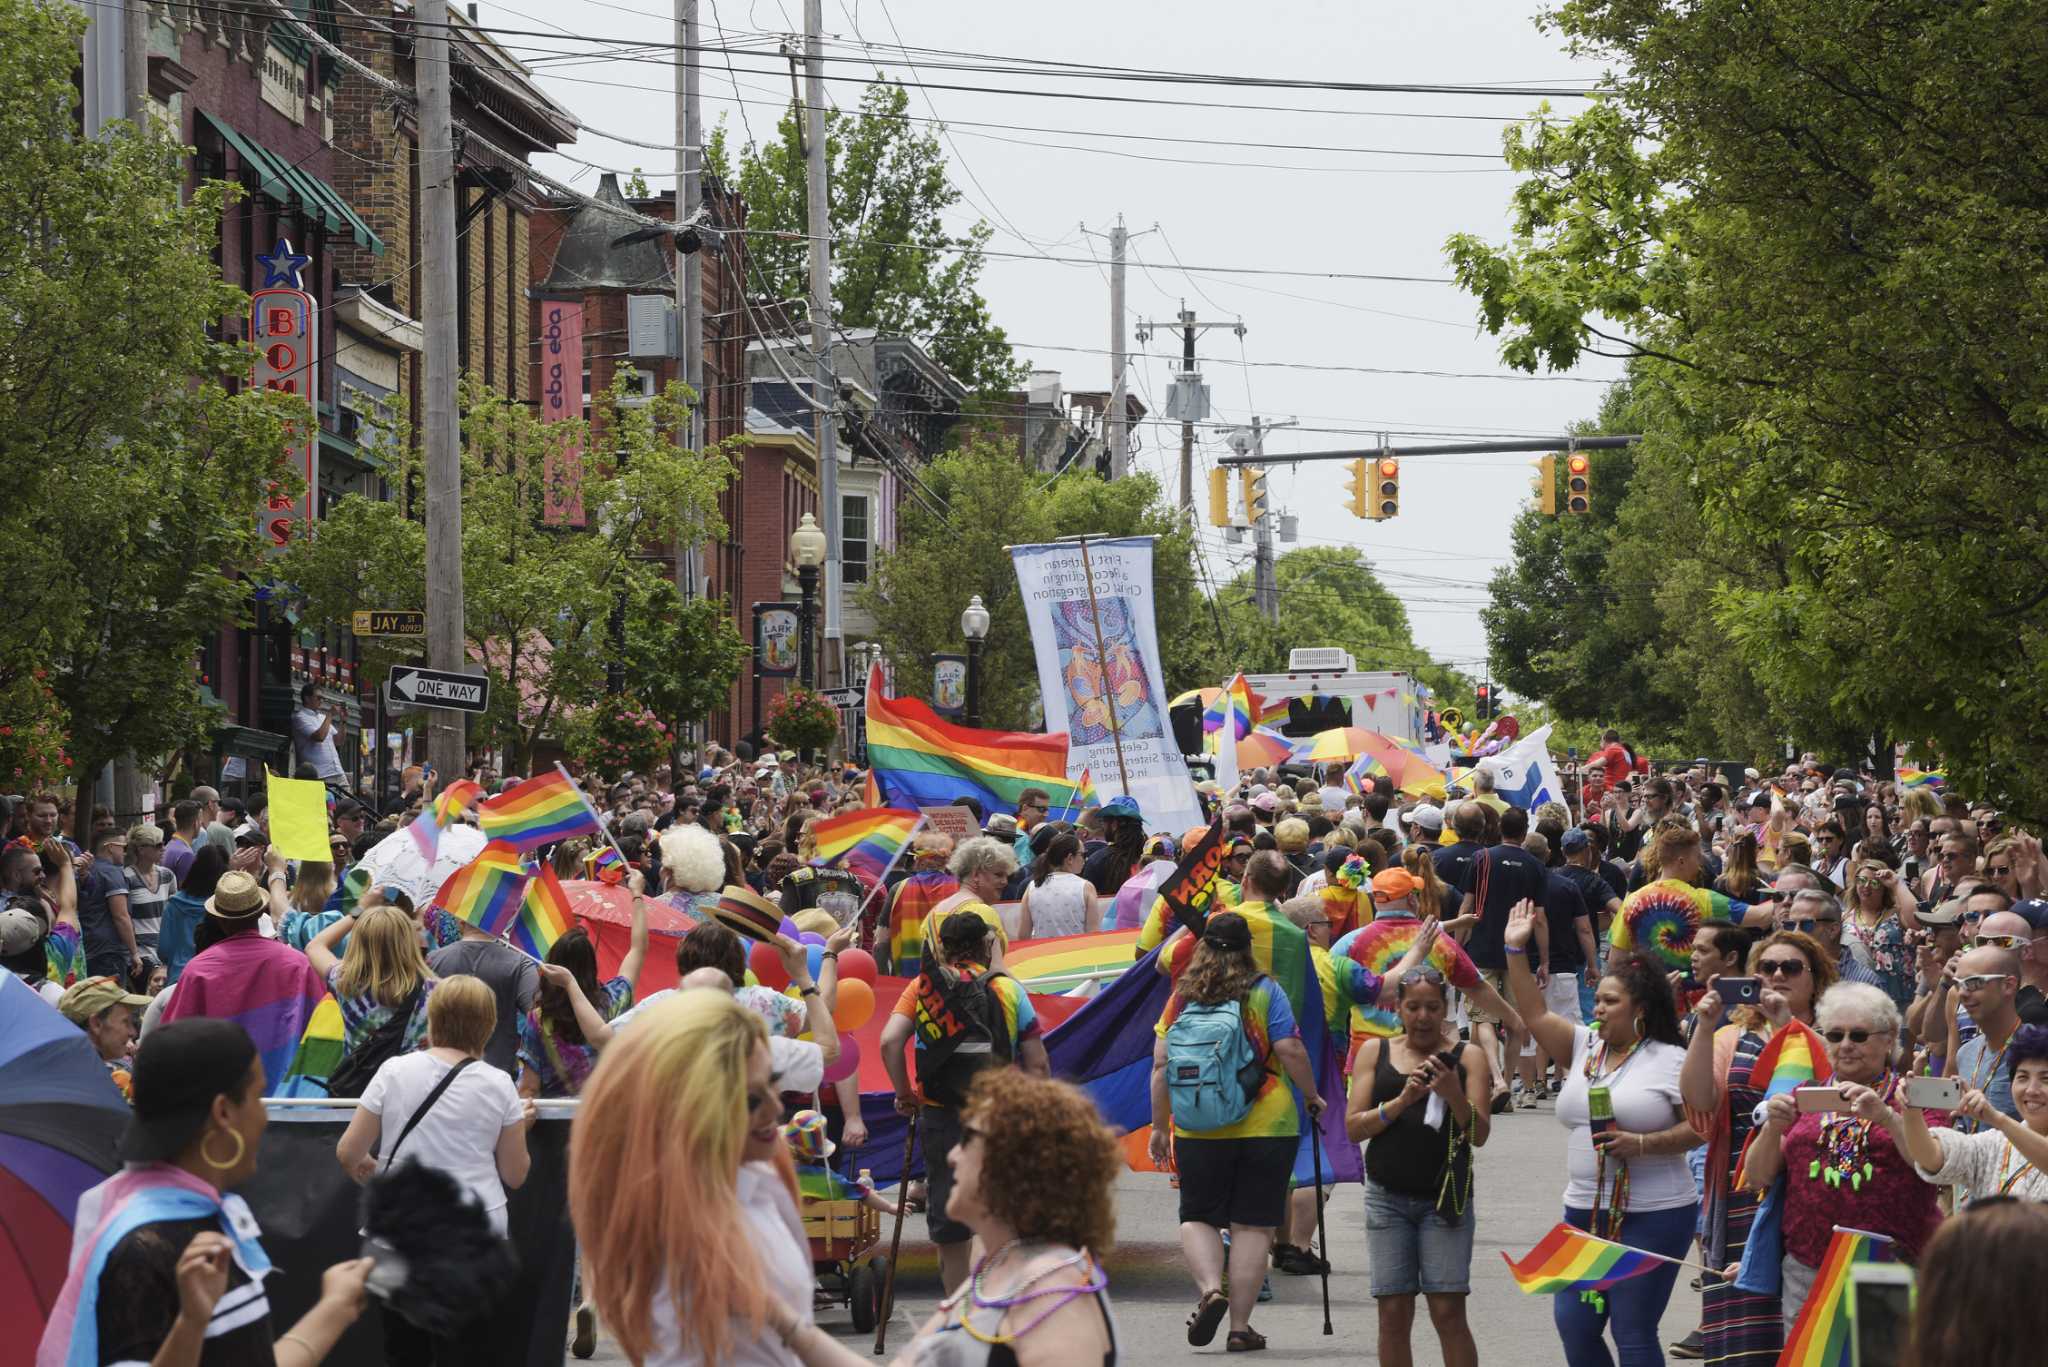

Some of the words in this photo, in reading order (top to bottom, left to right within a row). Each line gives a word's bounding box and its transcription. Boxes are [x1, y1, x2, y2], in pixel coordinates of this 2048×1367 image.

[544, 308, 561, 354] eba
[544, 362, 562, 410] eba
[267, 308, 296, 547] BOMRS
[373, 616, 399, 630] JAY
[764, 624, 792, 634] LARK
[417, 680, 444, 696] ONE
[448, 684, 477, 699] WAY
